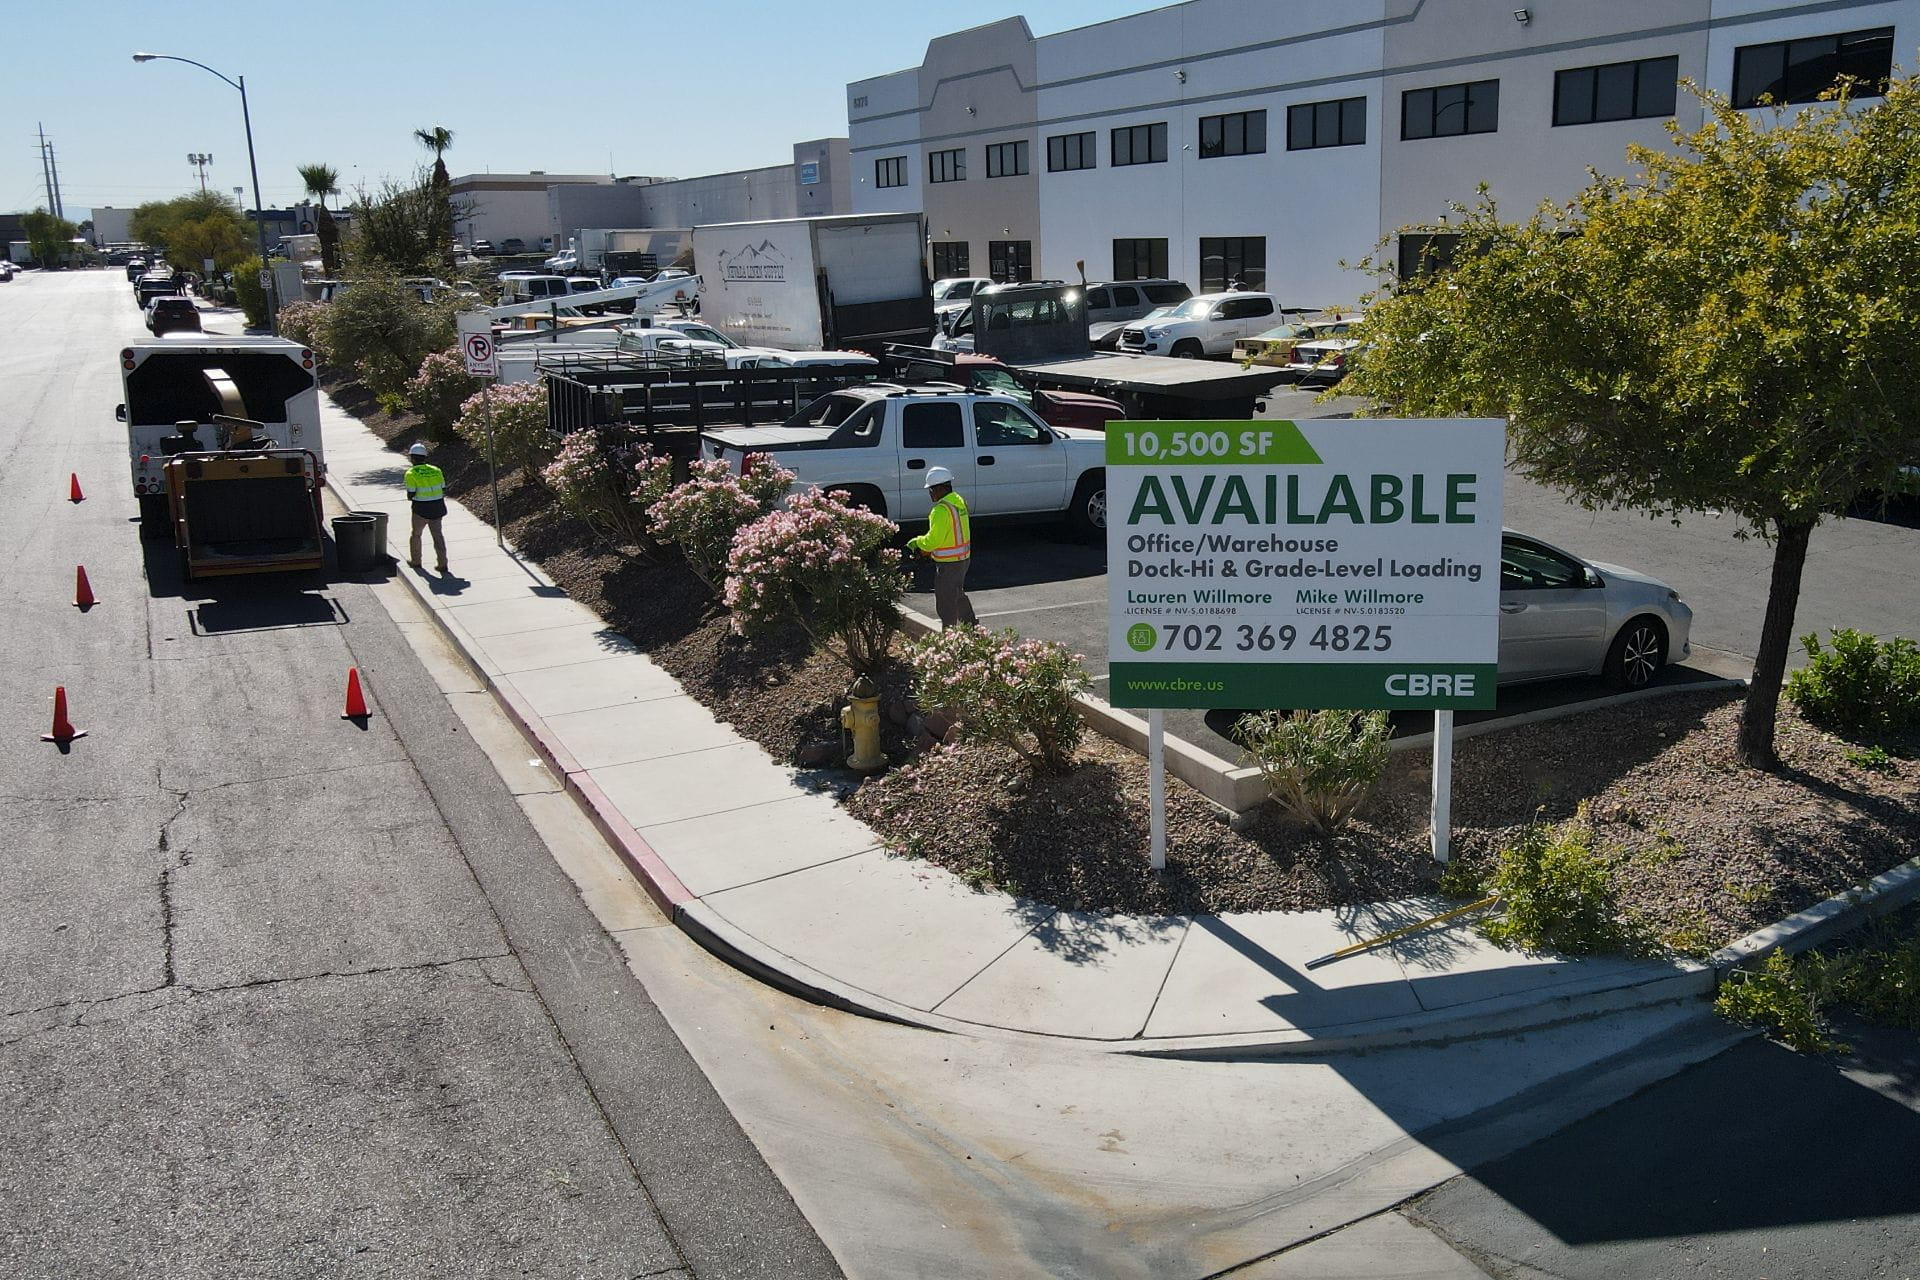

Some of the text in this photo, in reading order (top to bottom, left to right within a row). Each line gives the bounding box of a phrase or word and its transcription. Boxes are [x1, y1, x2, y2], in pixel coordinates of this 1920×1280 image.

[1124, 431, 1273, 460] 10,500 SF
[1127, 473, 1477, 525] AVAILABLE
[1127, 533, 1339, 556] Office/Warehouse
[1128, 558, 1482, 582] Dock-Hi & Grade-Level Loading
[1128, 589, 1272, 604] Lauren Willmore
[1296, 589, 1424, 604] Mike Willmore
[1126, 607, 1162, 615] LICENSE
[1296, 607, 1331, 615] LICENSE
[1163, 624, 1392, 652] 702 369 4825
[1127, 674, 1476, 697] www.cbre.us CBRE
